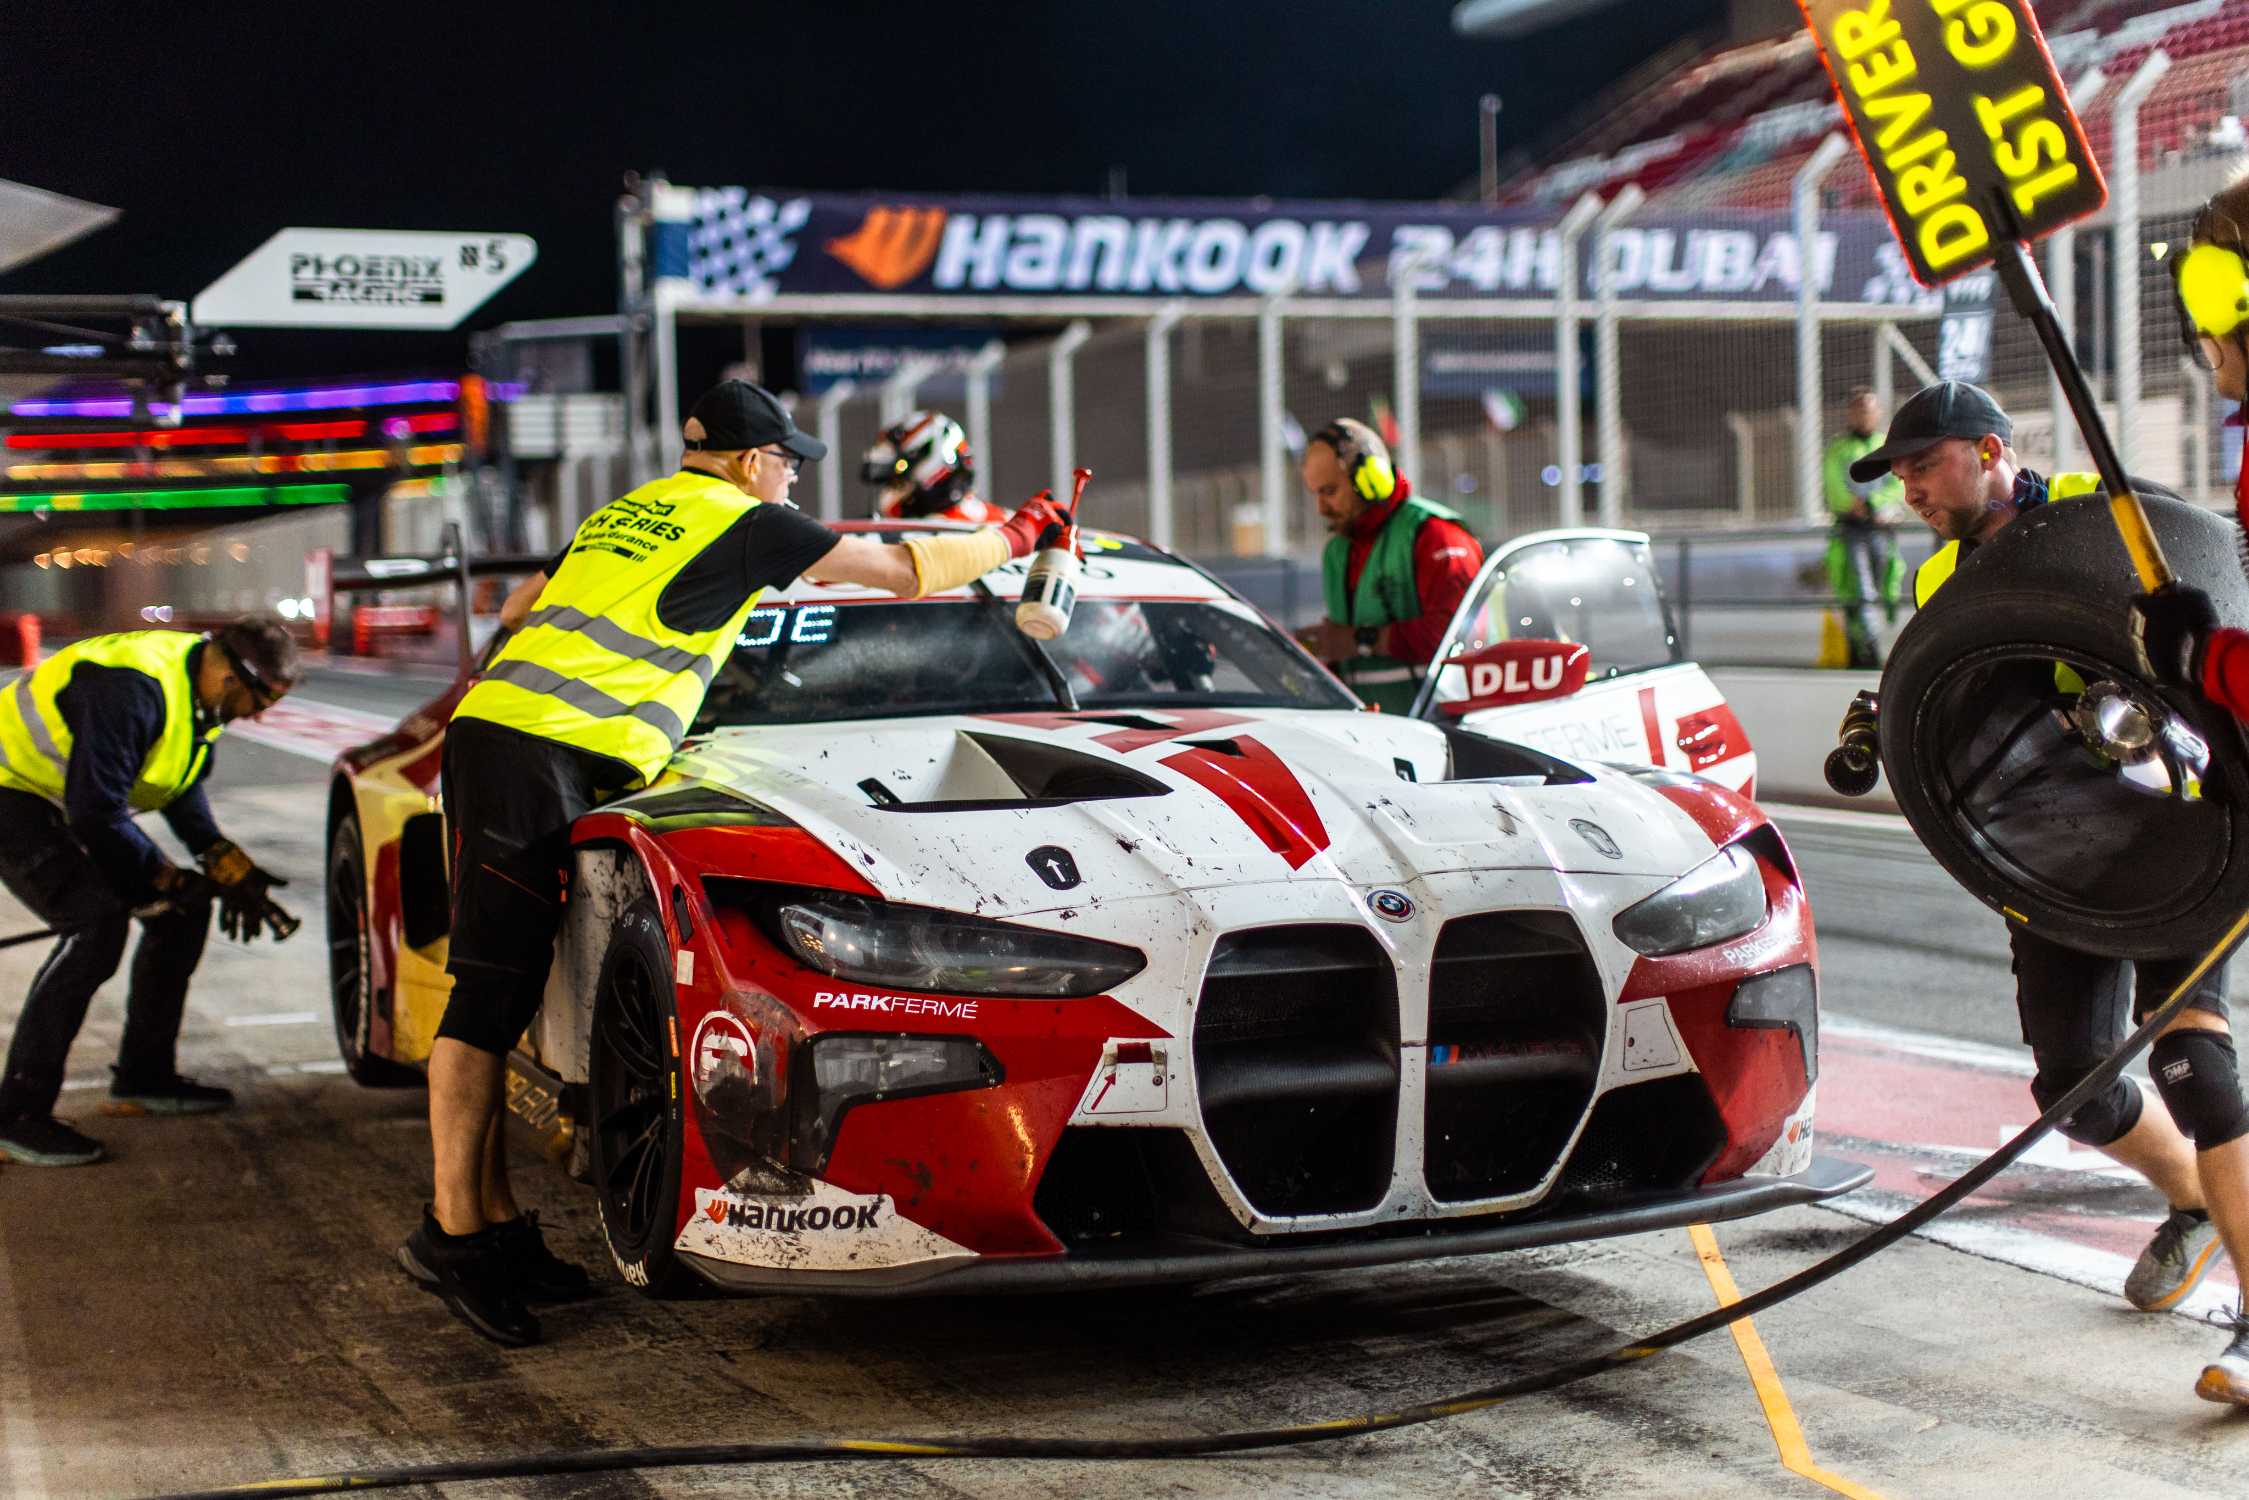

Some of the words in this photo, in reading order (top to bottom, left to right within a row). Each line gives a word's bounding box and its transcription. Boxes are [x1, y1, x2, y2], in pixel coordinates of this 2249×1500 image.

[1932, 0, 2016, 67] G
[1834, 0, 1989, 268] DRIVER
[1976, 86, 2077, 215] 1ST
[1387, 224, 1564, 292] 24H
[1587, 228, 1839, 292] DUBAI
[609, 517, 686, 541] SRIES
[1472, 655, 1563, 697] DLU
[813, 992, 979, 1019] PARKFERMÉ
